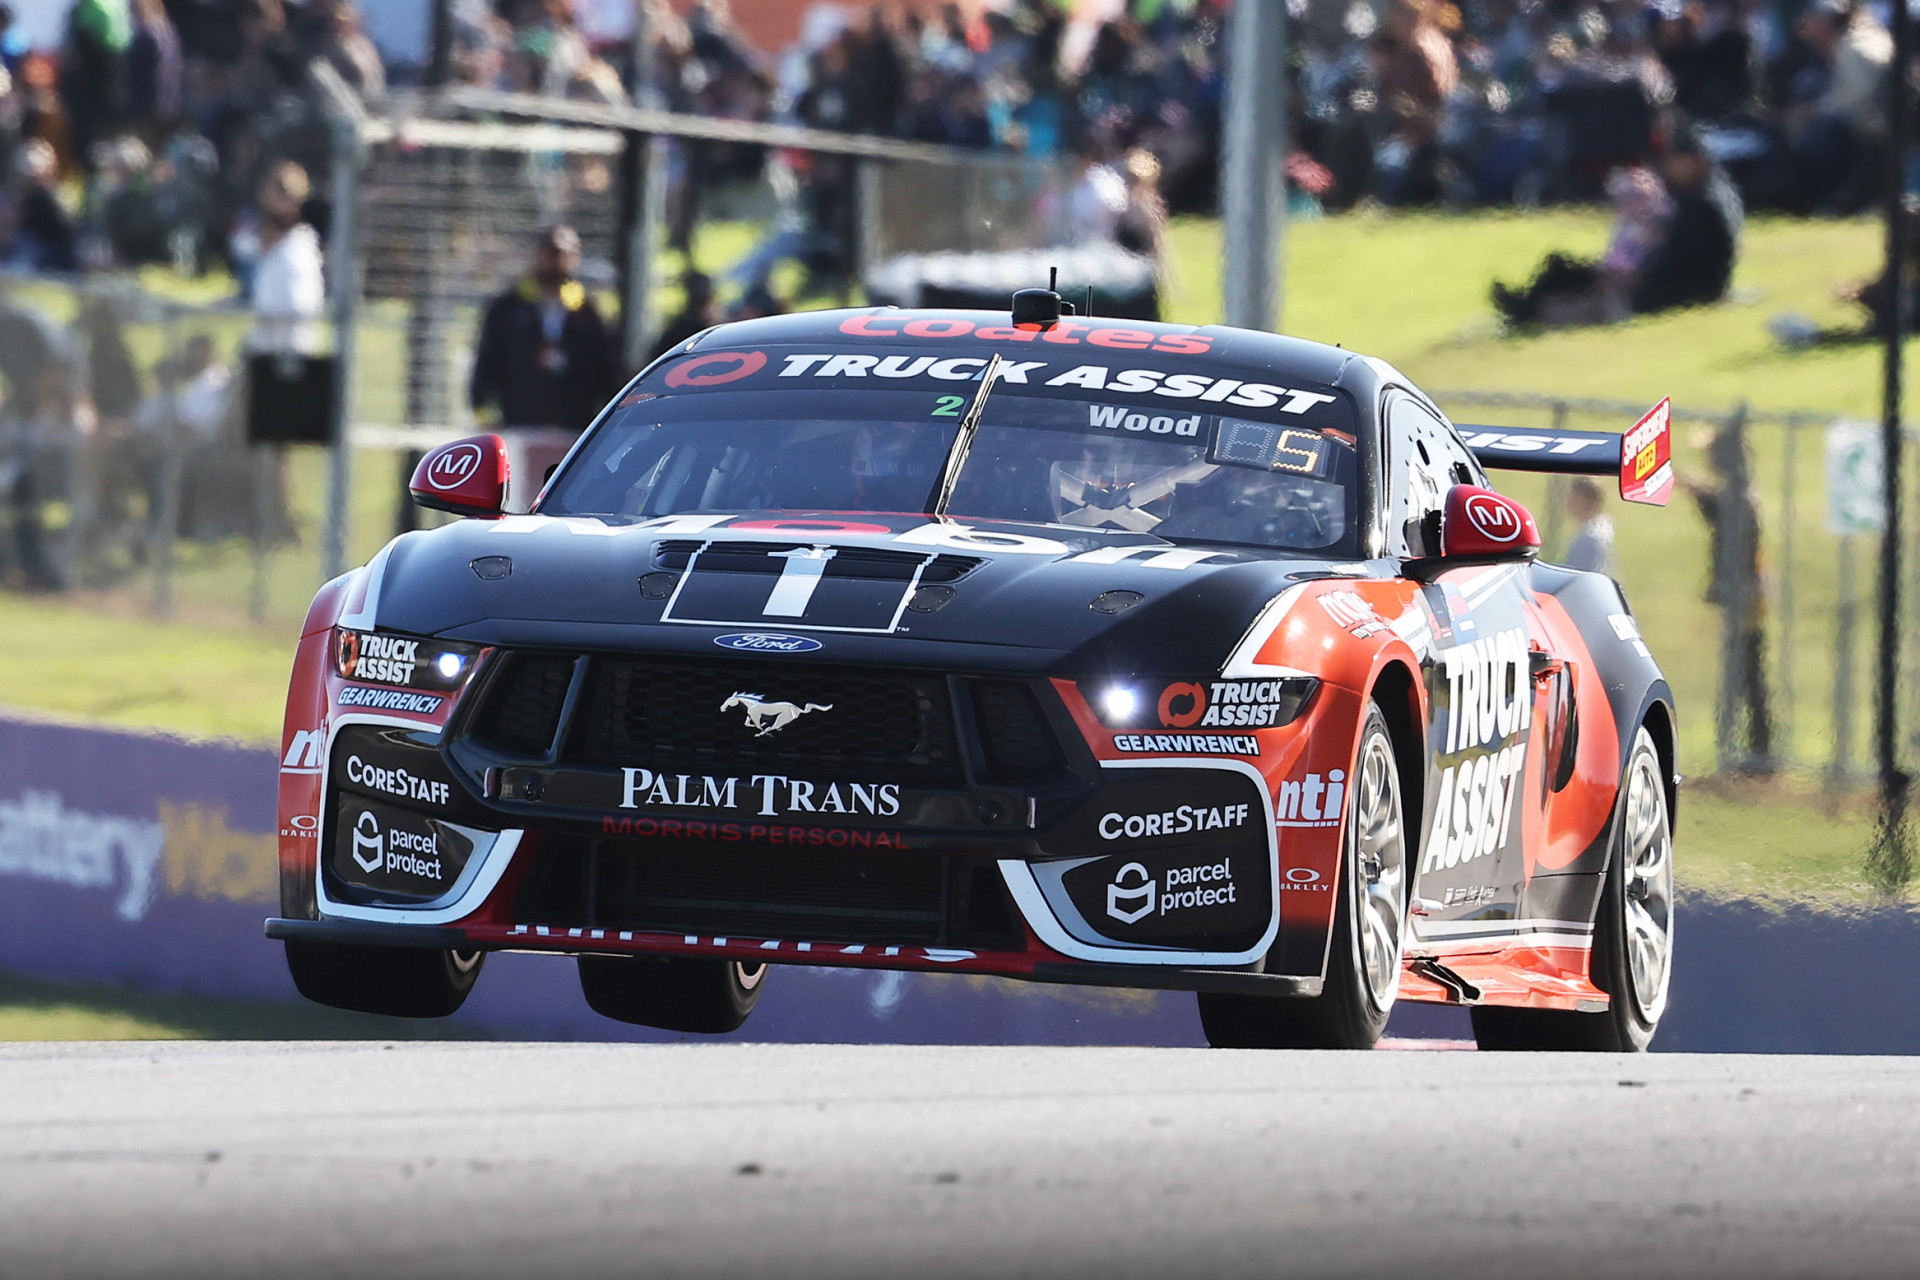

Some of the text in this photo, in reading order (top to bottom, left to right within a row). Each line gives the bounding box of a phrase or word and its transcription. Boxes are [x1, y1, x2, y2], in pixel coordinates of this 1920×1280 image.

[778, 354, 1337, 415] TRUCK ASSIST
[930, 396, 964, 417] 2
[1089, 405, 1201, 437] Wood
[435, 453, 473, 475] M
[1637, 449, 1655, 472] AUTO
[1473, 505, 1513, 526] M
[762, 544, 838, 617] 1
[360, 635, 419, 662] TRUCK
[732, 634, 802, 650] Ford
[354, 656, 415, 684] ASSIST
[337, 687, 442, 713] GEARWRENCH
[1209, 682, 1283, 704] TRUCK
[1443, 627, 1531, 755] TRUCK
[1200, 703, 1280, 727] ASSIST
[1113, 735, 1260, 755] GEARWRENCH
[1277, 769, 1345, 821] nti
[1421, 743, 1527, 875] ASSIST
[390, 828, 438, 856] parcel
[602, 815, 911, 850] MORRIS PERSONAL
[386, 850, 442, 880] protect
[1166, 858, 1232, 890] parcel
[1160, 882, 1236, 916] protect
